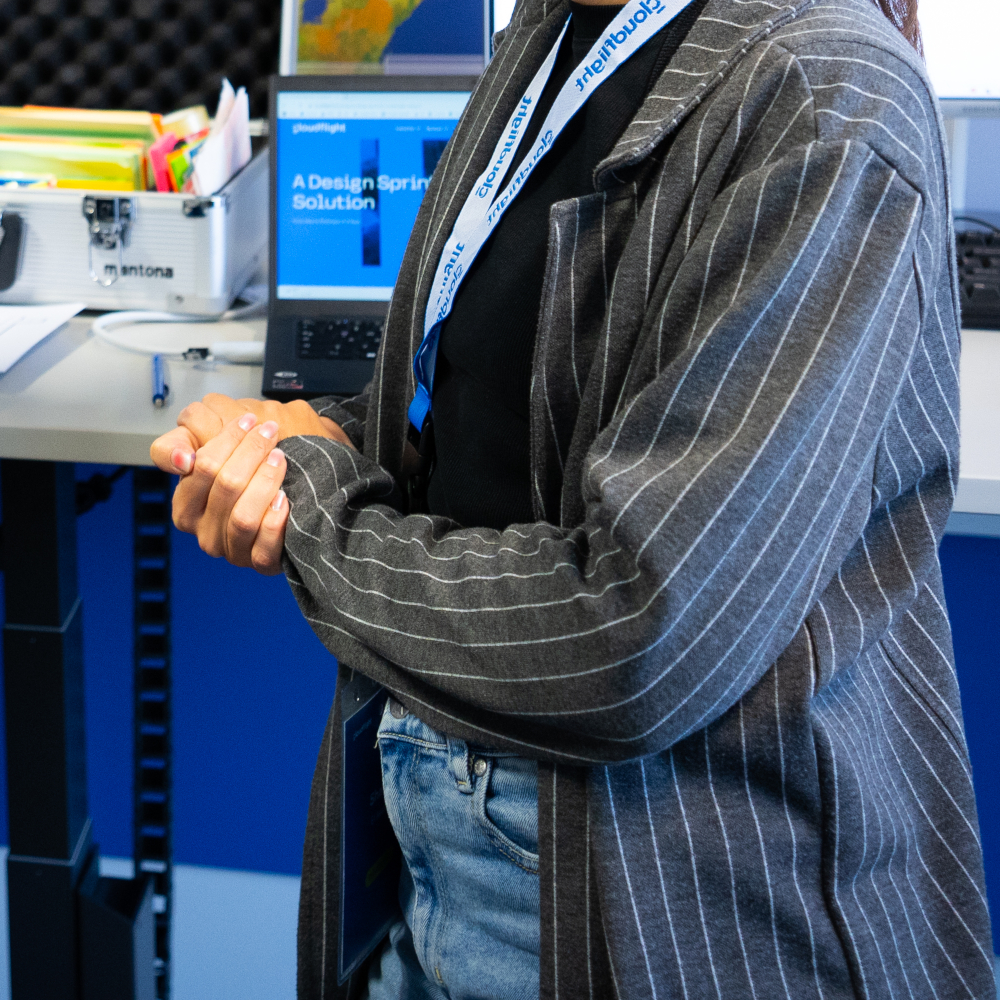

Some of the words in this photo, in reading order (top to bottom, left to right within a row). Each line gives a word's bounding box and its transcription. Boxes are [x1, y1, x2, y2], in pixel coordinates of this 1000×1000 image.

[292, 174, 306, 190] A
[308, 173, 375, 194] Design
[292, 193, 375, 210] Solution
[104, 264, 174, 278] mantona
